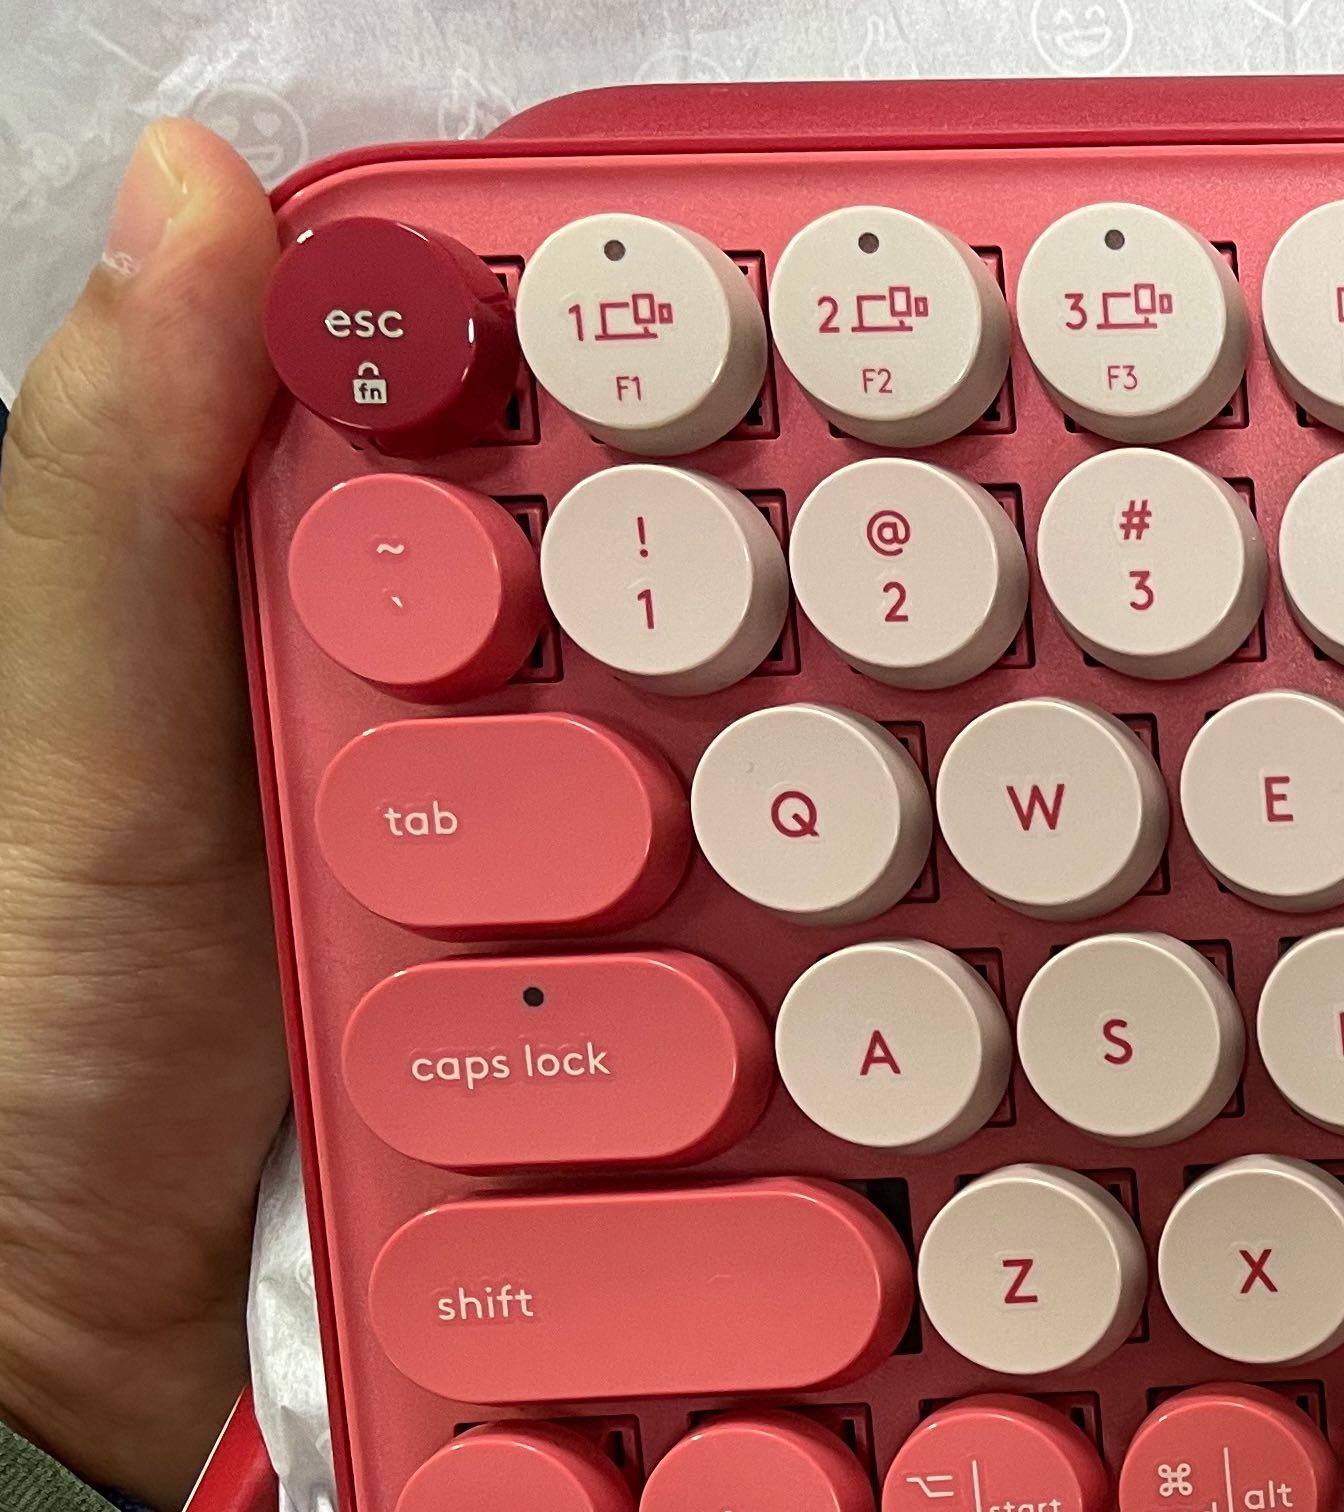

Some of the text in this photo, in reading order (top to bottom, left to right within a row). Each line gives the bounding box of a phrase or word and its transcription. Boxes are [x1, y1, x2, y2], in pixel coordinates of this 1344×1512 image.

[324, 309, 404, 338] esc
[568, 303, 585, 342] 1
[817, 295, 841, 334] 2
[1064, 292, 1088, 331] 3
[615, 375, 642, 402] F1
[862, 367, 893, 394] F2
[1107, 364, 1138, 391] F3
[636, 516, 649, 559] !
[866, 509, 911, 557] @
[1119, 499, 1153, 541] #
[637, 588, 655, 630] 1
[882, 581, 909, 623] 2
[1128, 570, 1155, 611] 3
[384, 800, 458, 836] tab
[770, 790, 820, 838] Q
[1006, 783, 1065, 832] W
[1264, 775, 1294, 823] E
[859, 1029, 902, 1076] A
[1102, 1018, 1133, 1065] S
[411, 1041, 611, 1090] caps lock
[1002, 1258, 1039, 1305] Z
[1238, 1248, 1279, 1294] X
[438, 1283, 534, 1321] shift
[1244, 1479, 1294, 1510] alt
